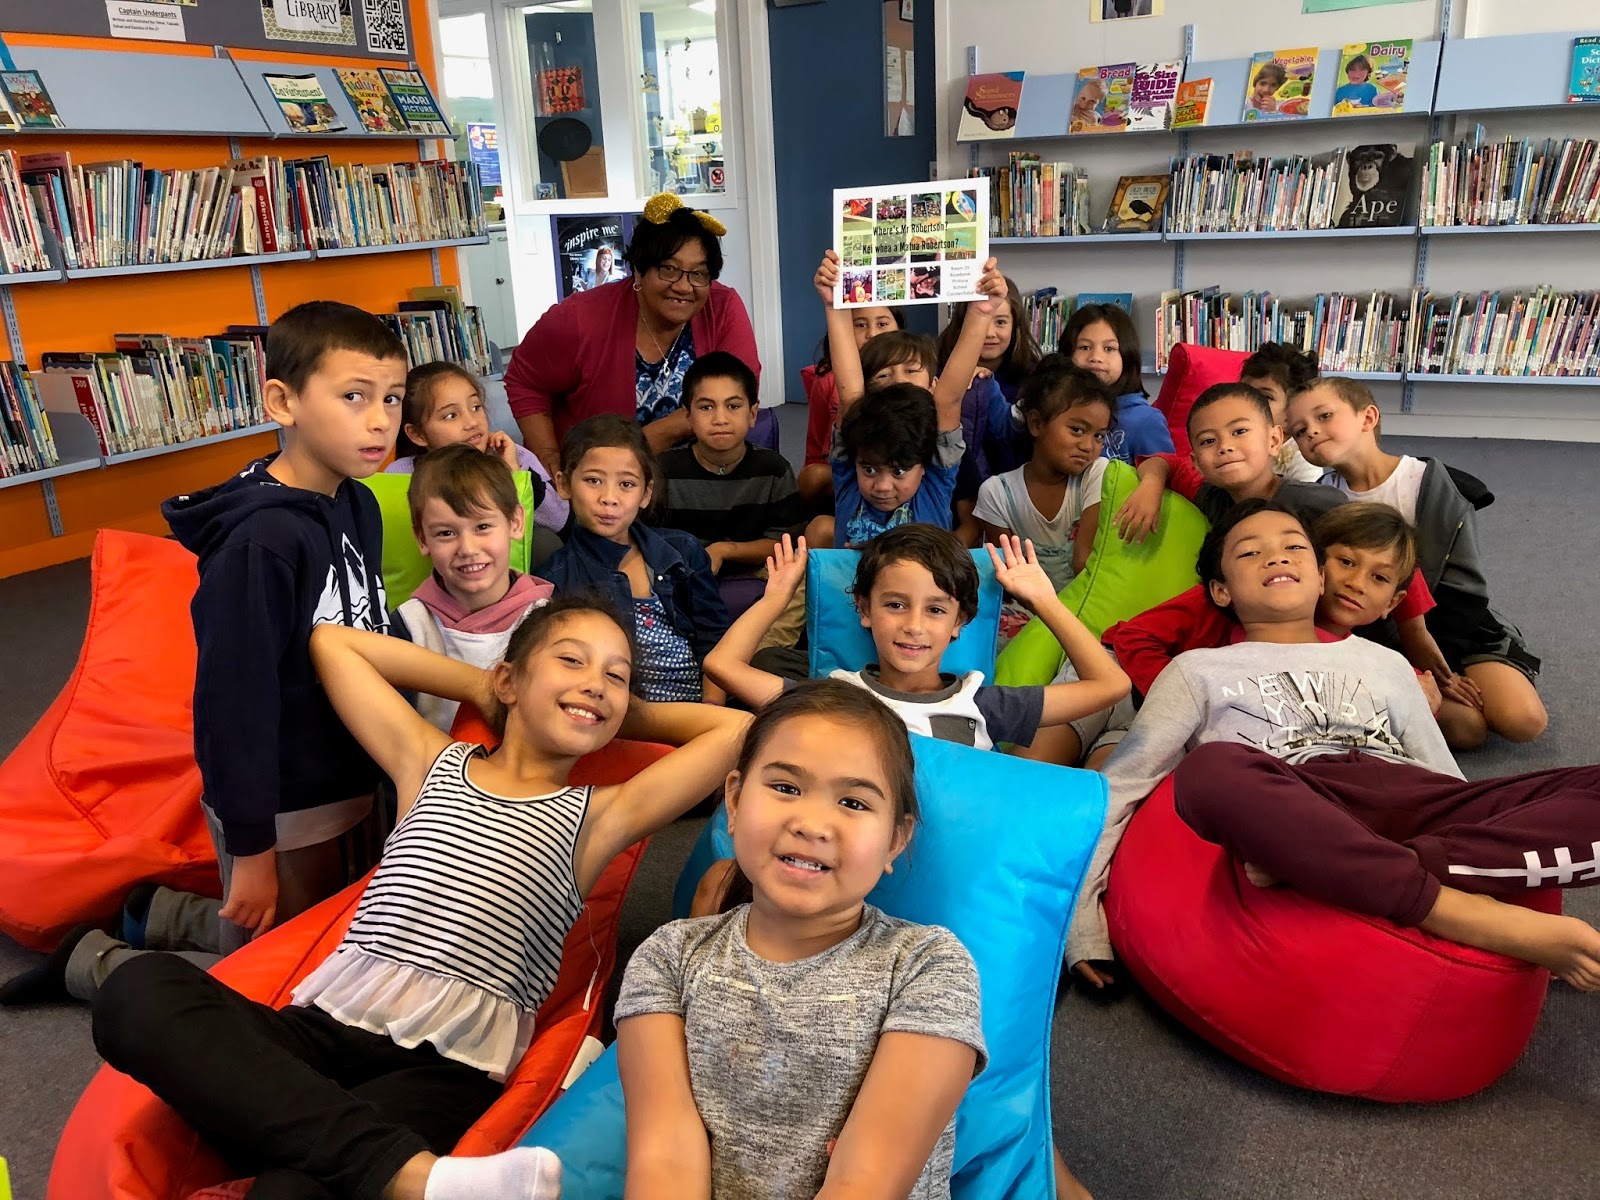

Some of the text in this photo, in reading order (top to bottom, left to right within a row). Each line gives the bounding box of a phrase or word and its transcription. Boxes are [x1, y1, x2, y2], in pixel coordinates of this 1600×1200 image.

[118, 7, 177, 18] Captain Underpants
[1370, 44, 1406, 59] Dairy
[1274, 56, 1314, 66] Vegetables
[1101, 66, 1132, 79] Bread
[271, 83, 323, 97] Environment
[975, 91, 1016, 101] Swimmers
[979, 85, 999, 94] Sand
[1350, 193, 1398, 222] Ape
[259, 195, 272, 245] Language
[873, 222, 949, 236] Where's Mr Robertson?
[863, 244, 873, 254] Kei
[875, 243, 892, 253] whea
[899, 242, 920, 252] Matua
[922, 238, 959, 250] Robertson?
[75, 380, 87, 388] 500
[1221, 671, 1326, 698] NEW
